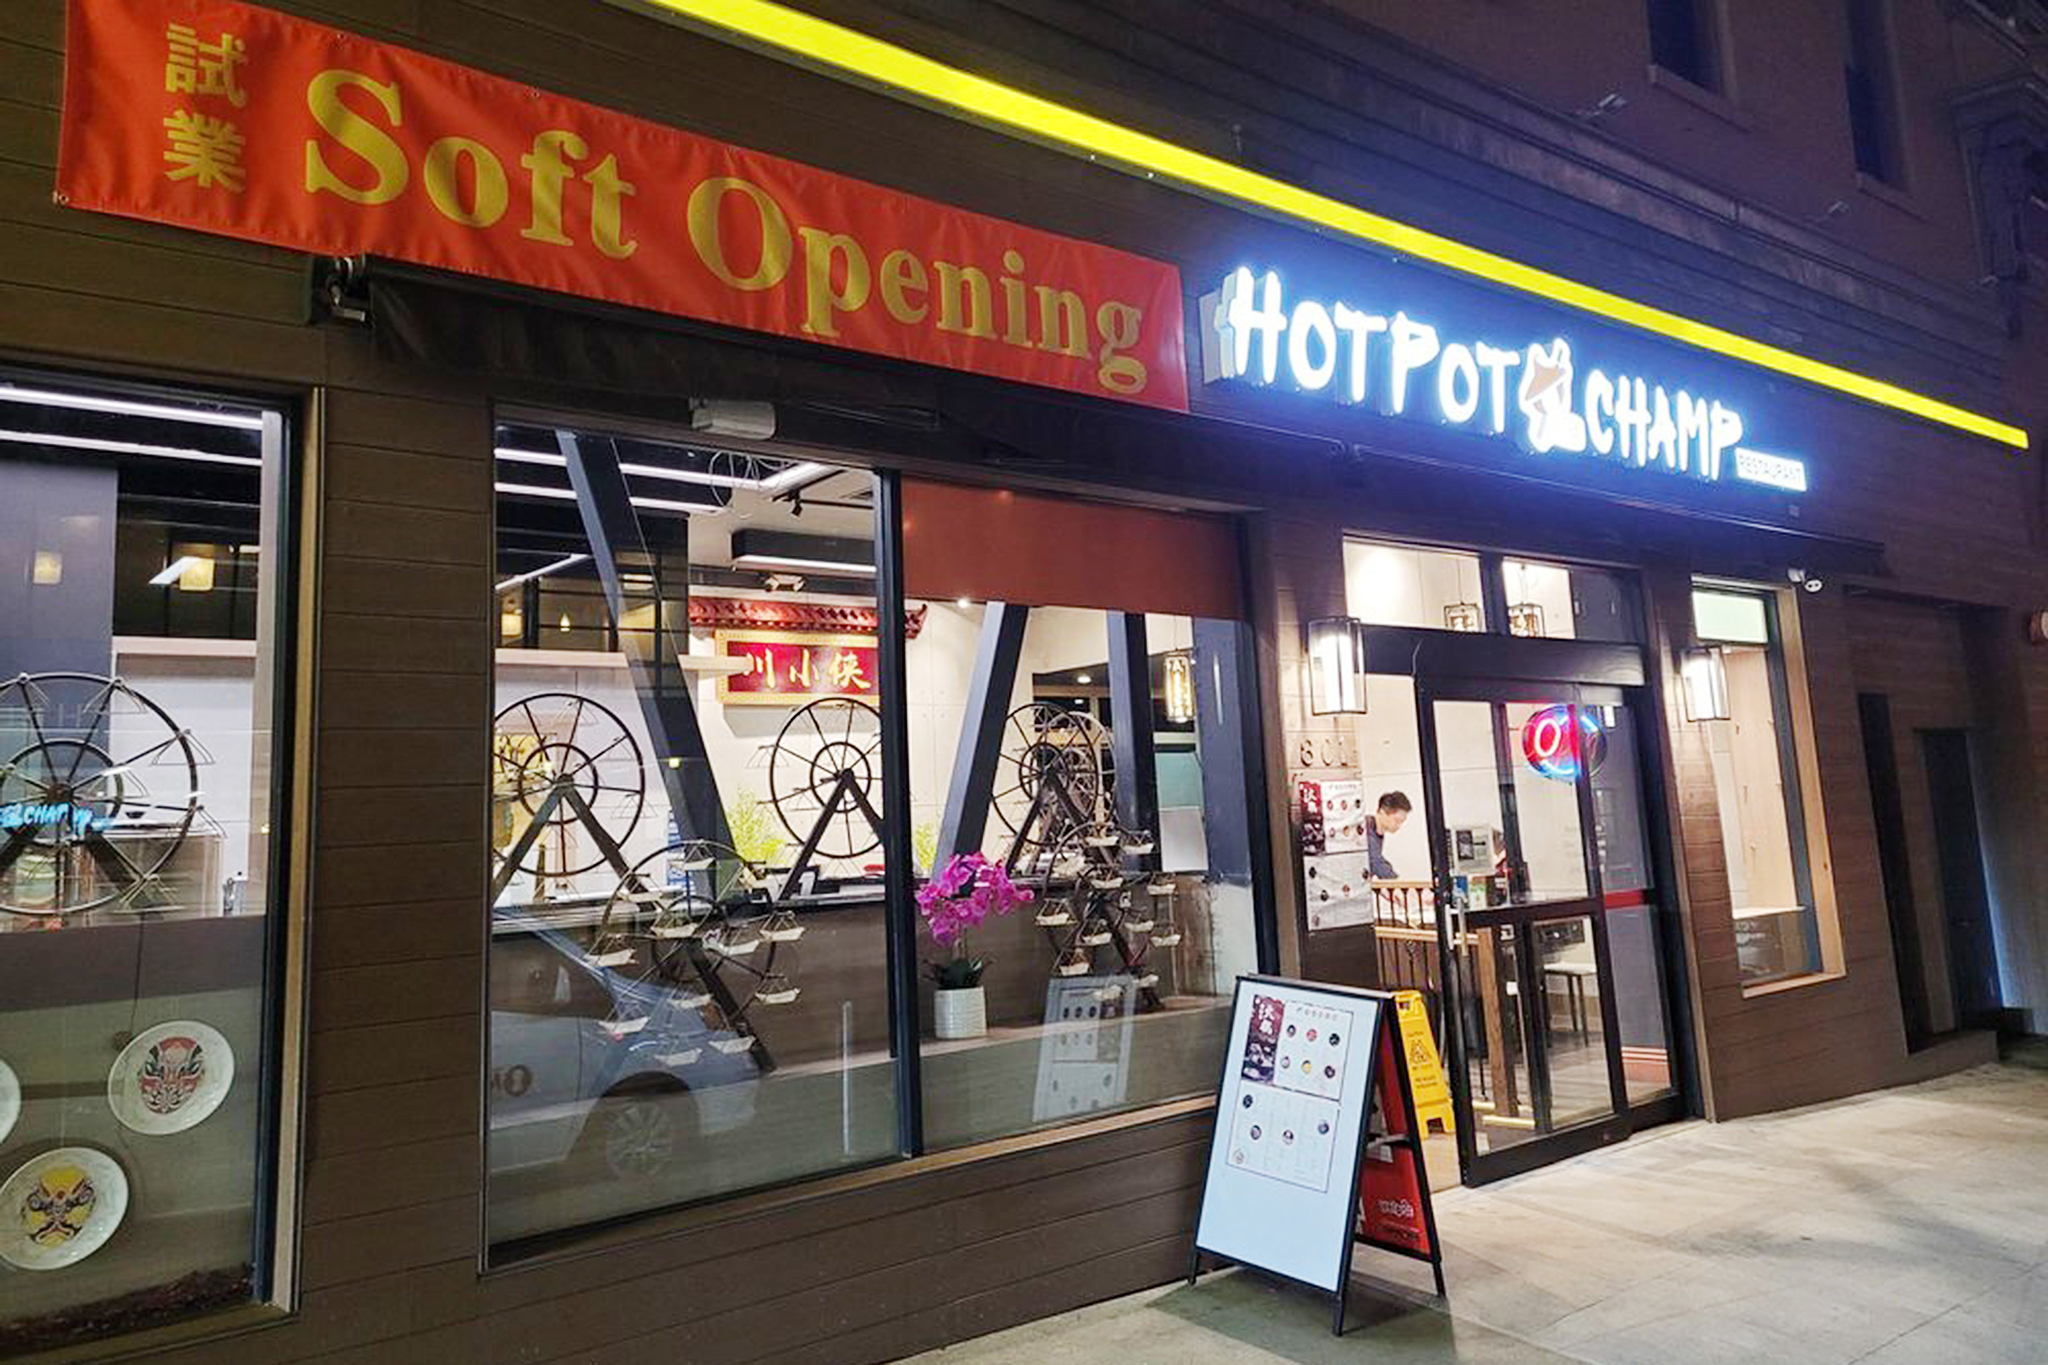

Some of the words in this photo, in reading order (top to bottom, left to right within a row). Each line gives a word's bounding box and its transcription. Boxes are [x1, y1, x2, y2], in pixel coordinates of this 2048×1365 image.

[163, 22, 249, 194] 試業
[304, 68, 639, 260] Soft
[686, 176, 1149, 395] Opening
[1584, 368, 1744, 481] CHAMP
